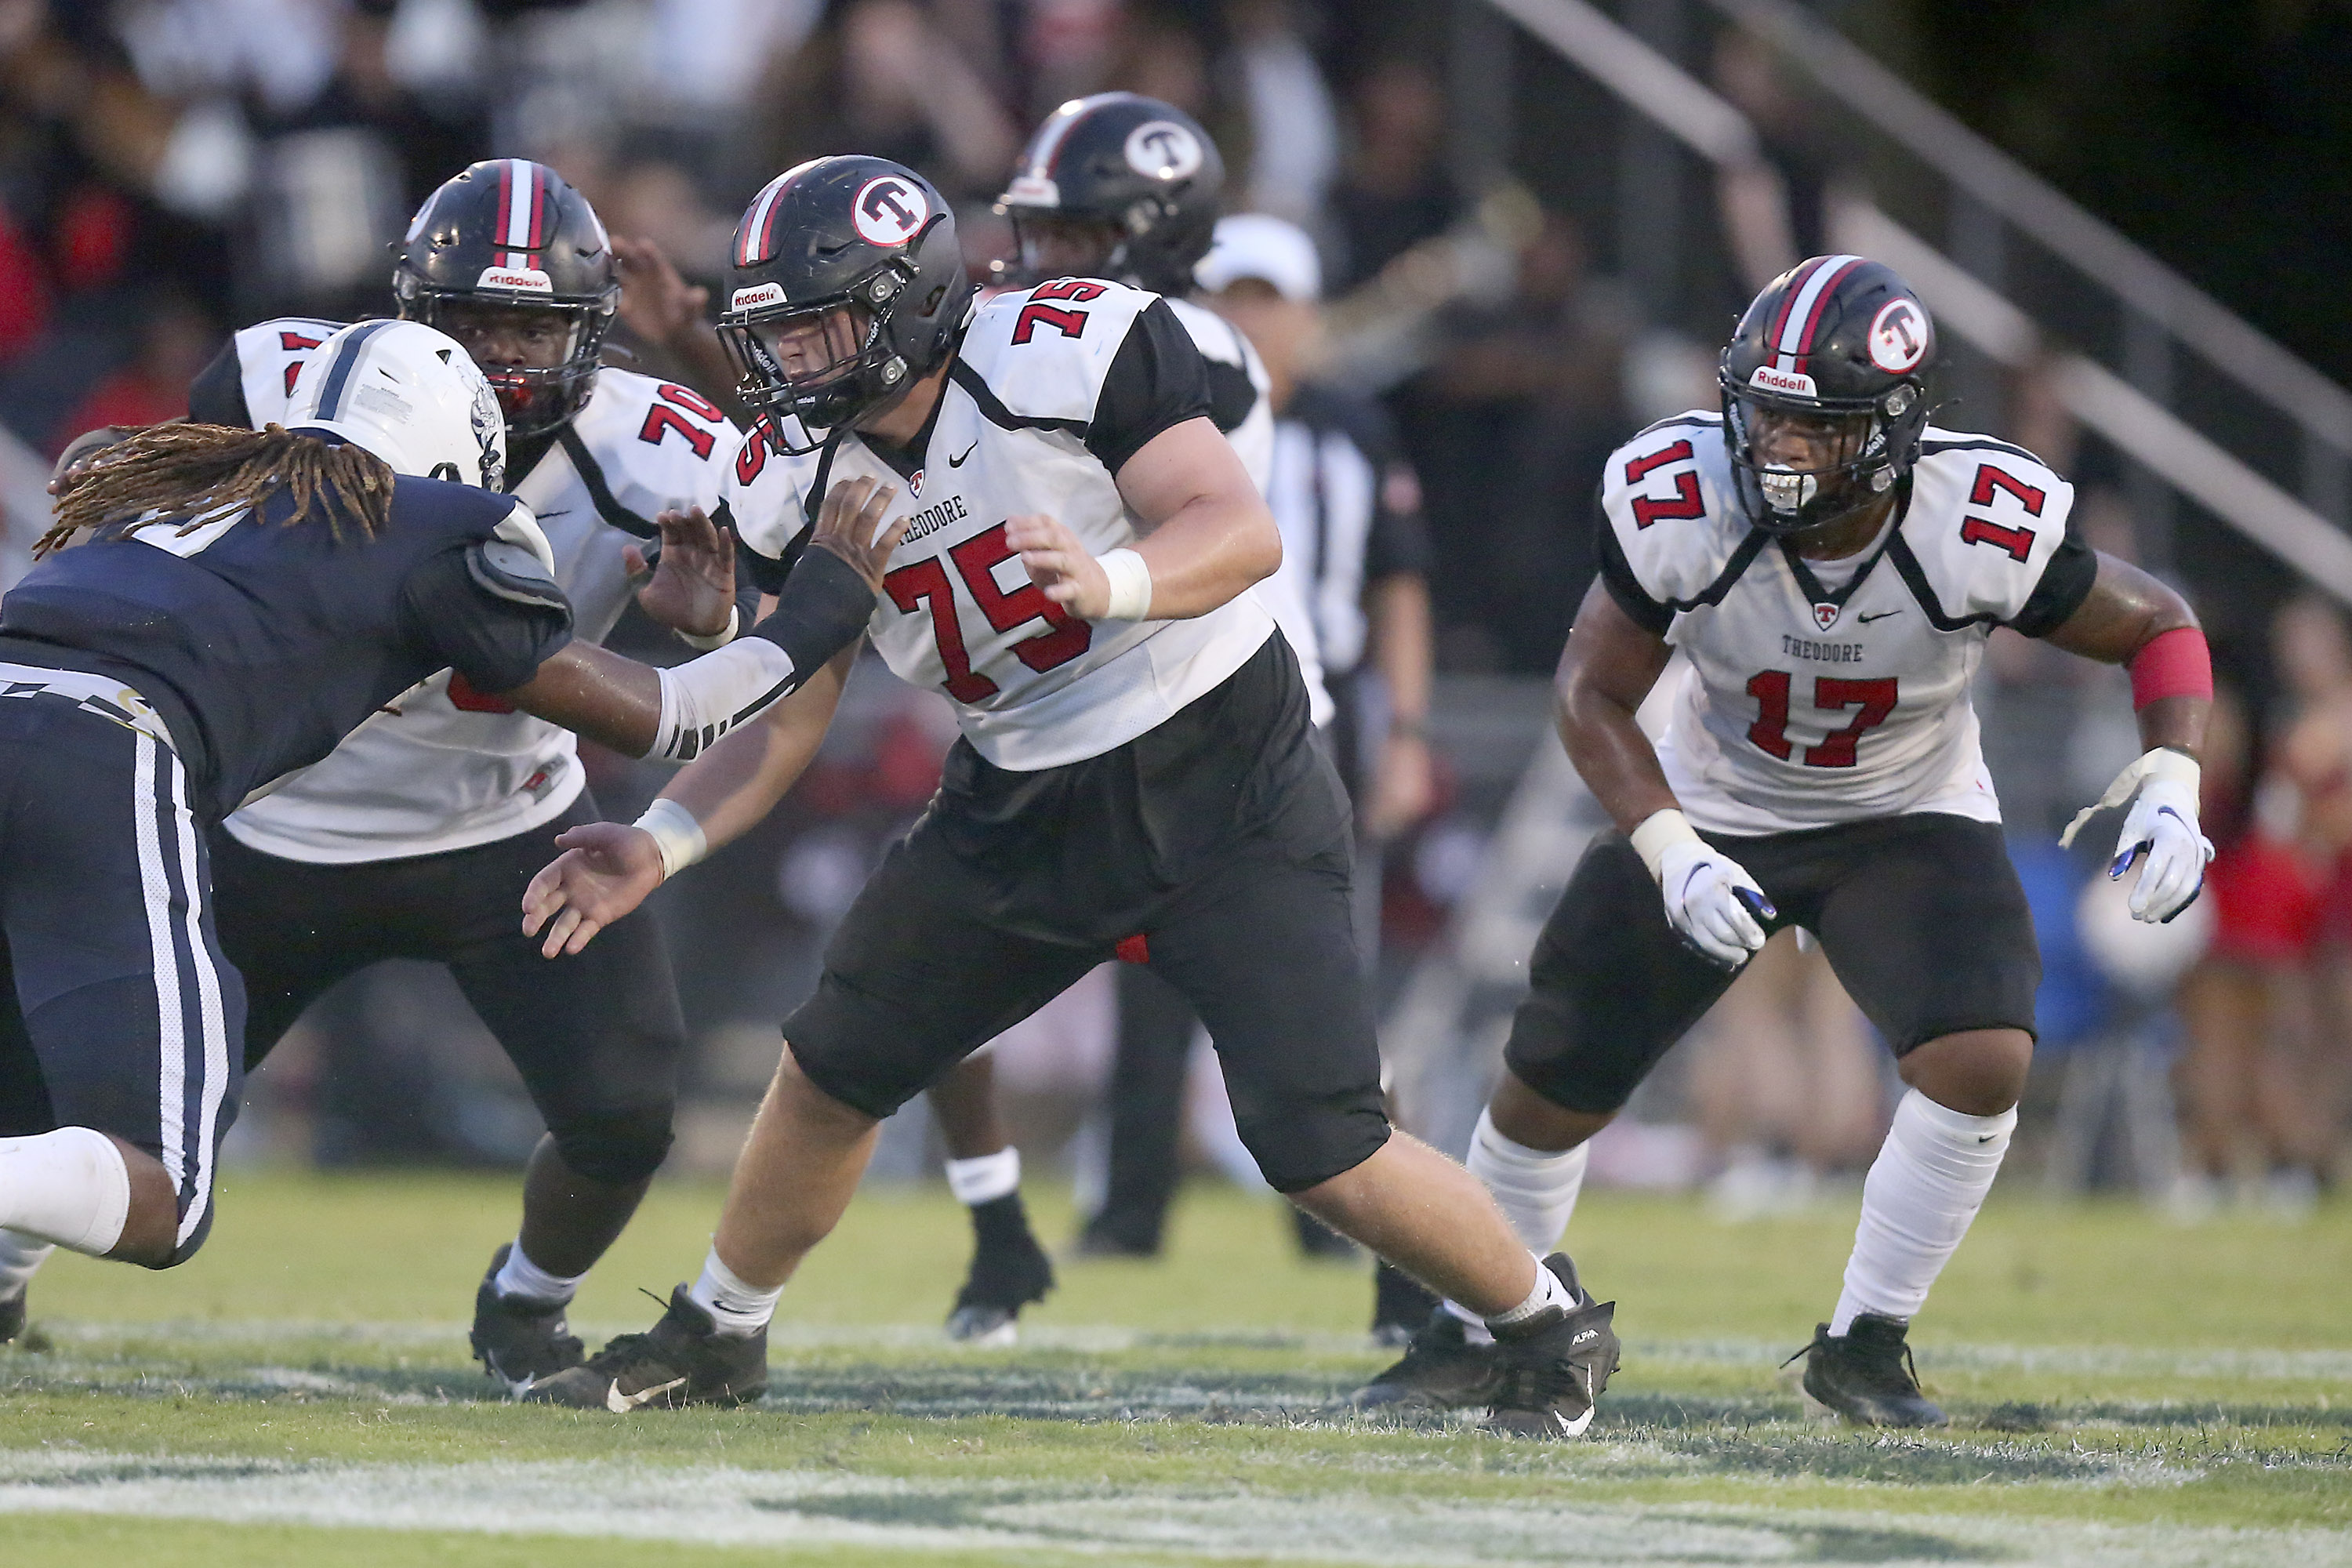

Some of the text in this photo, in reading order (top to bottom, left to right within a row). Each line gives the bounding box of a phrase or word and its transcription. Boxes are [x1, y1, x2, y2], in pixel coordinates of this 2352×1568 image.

[1144, 130, 1179, 167] T
[862, 181, 918, 232] T
[1011, 281, 1109, 346] 75
[1879, 305, 1919, 361] T
[1758, 371, 1807, 390] Riddell
[638, 384, 723, 462] 70
[911, 472, 922, 491] T
[1624, 439, 1707, 531] 17
[899, 495, 968, 546] HEODORE
[1959, 463, 2047, 564] 17
[882, 519, 1093, 704] 75
[1817, 605, 1836, 622] T
[1782, 634, 1863, 662] THEODORE
[1746, 670, 1899, 768] 17
[1572, 1329, 1599, 1346] ALPHA
